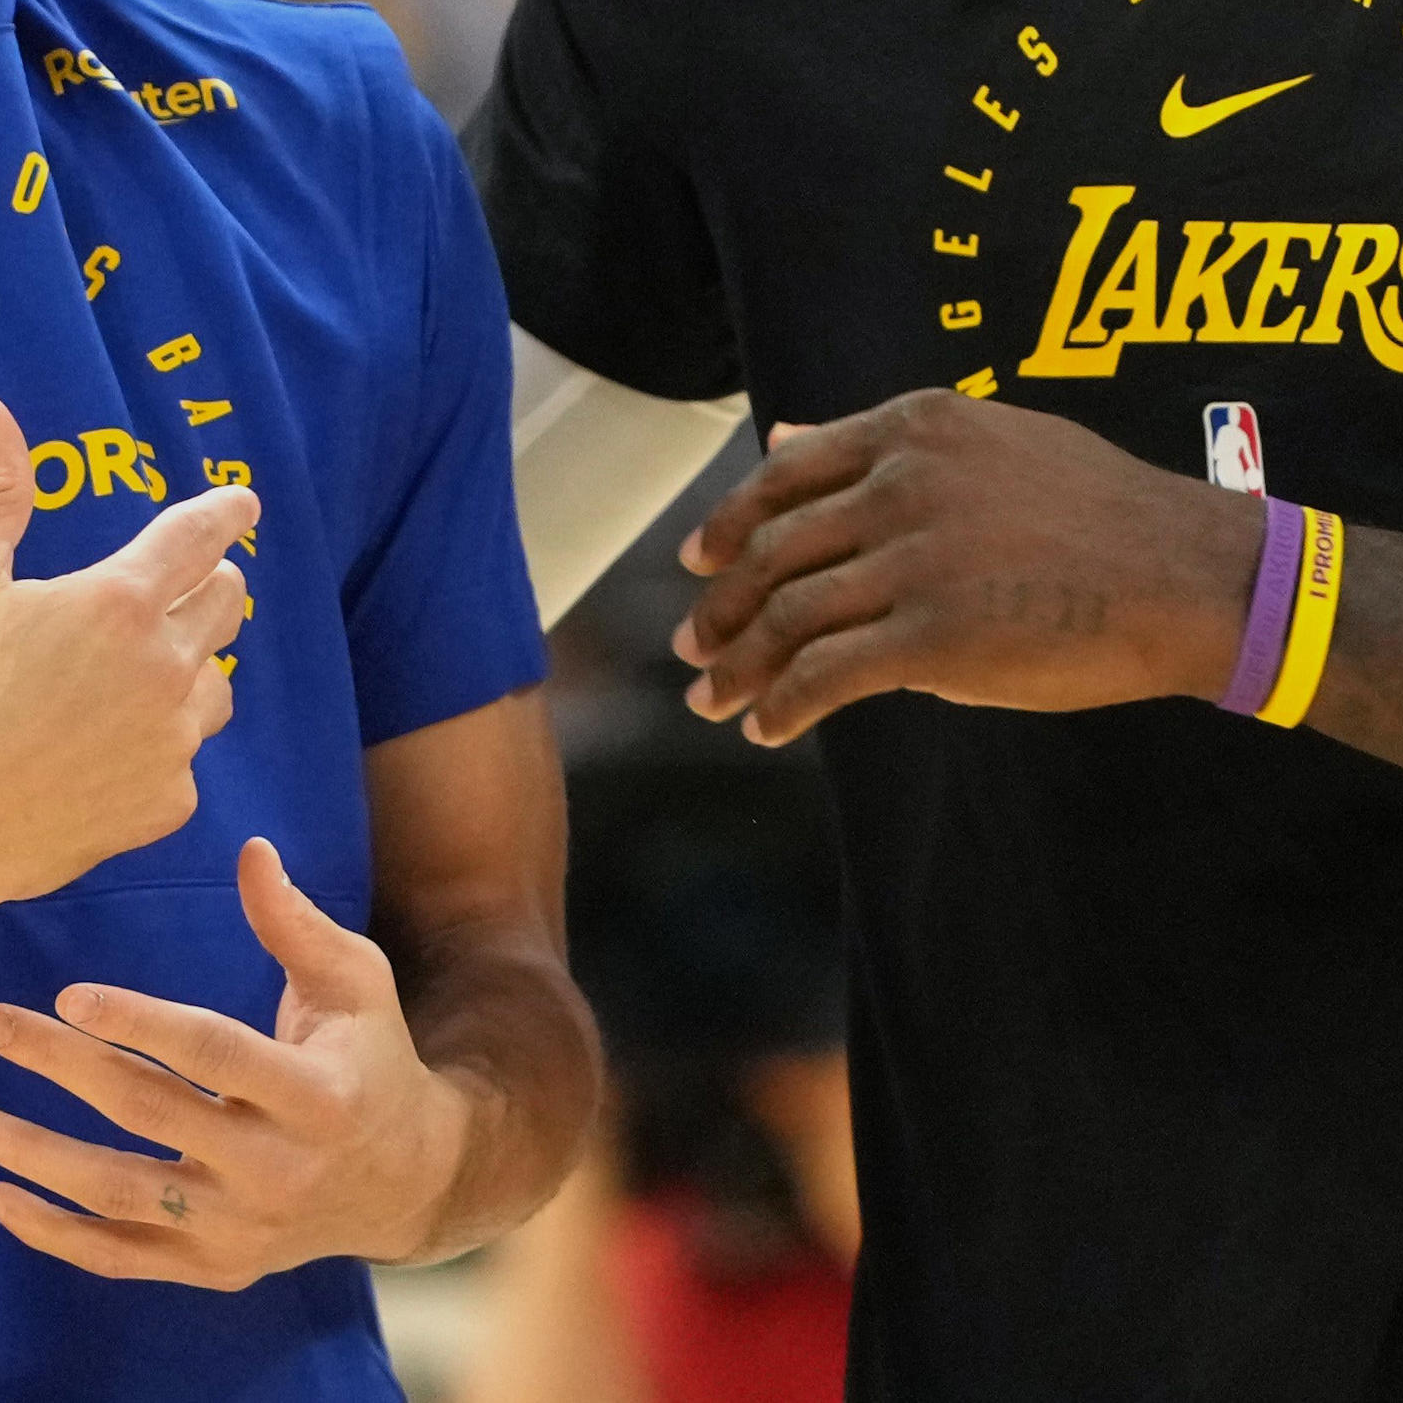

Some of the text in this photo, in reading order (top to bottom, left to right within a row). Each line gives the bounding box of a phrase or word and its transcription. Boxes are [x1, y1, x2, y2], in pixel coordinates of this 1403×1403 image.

[44, 47, 239, 120] Raten
[932, 25, 1060, 402] NGELES
[1311, 511, 1336, 586] PROMI
